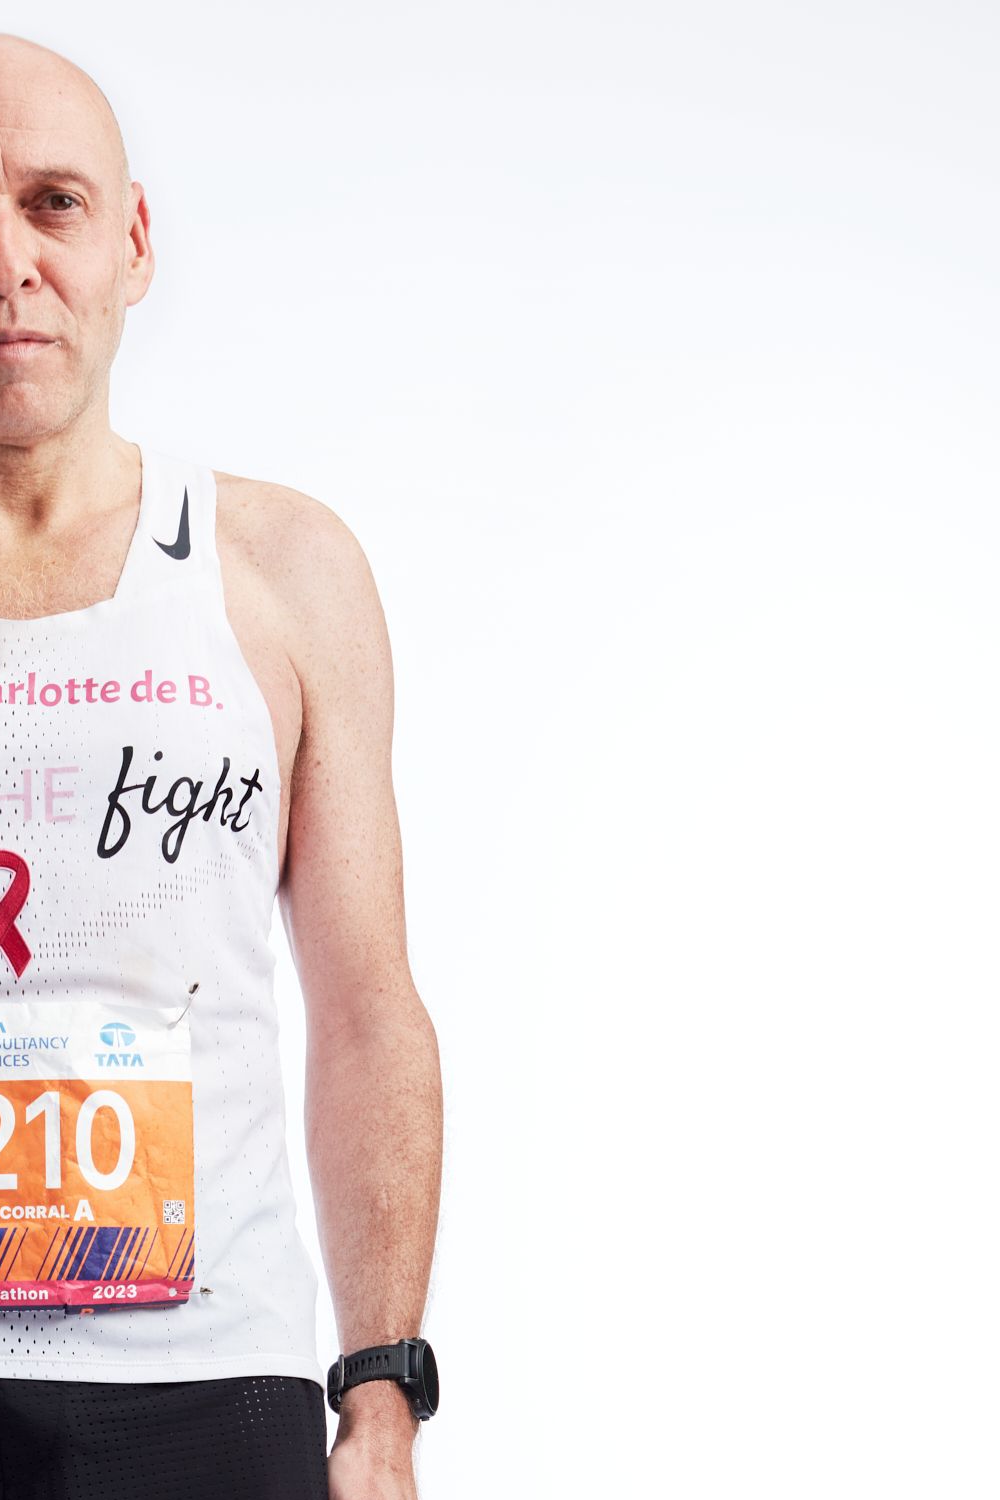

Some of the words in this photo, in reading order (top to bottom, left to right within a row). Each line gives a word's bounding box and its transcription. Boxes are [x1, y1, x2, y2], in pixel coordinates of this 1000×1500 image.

[130, 670, 178, 704] de
[187, 674, 224, 710] B.
[96, 745, 263, 864] fight
[94, 1053, 145, 1068] TATA
[0, 1204, 70, 1220] CORRAL
[73, 1199, 95, 1222] A
[92, 1284, 138, 1300] 2023
